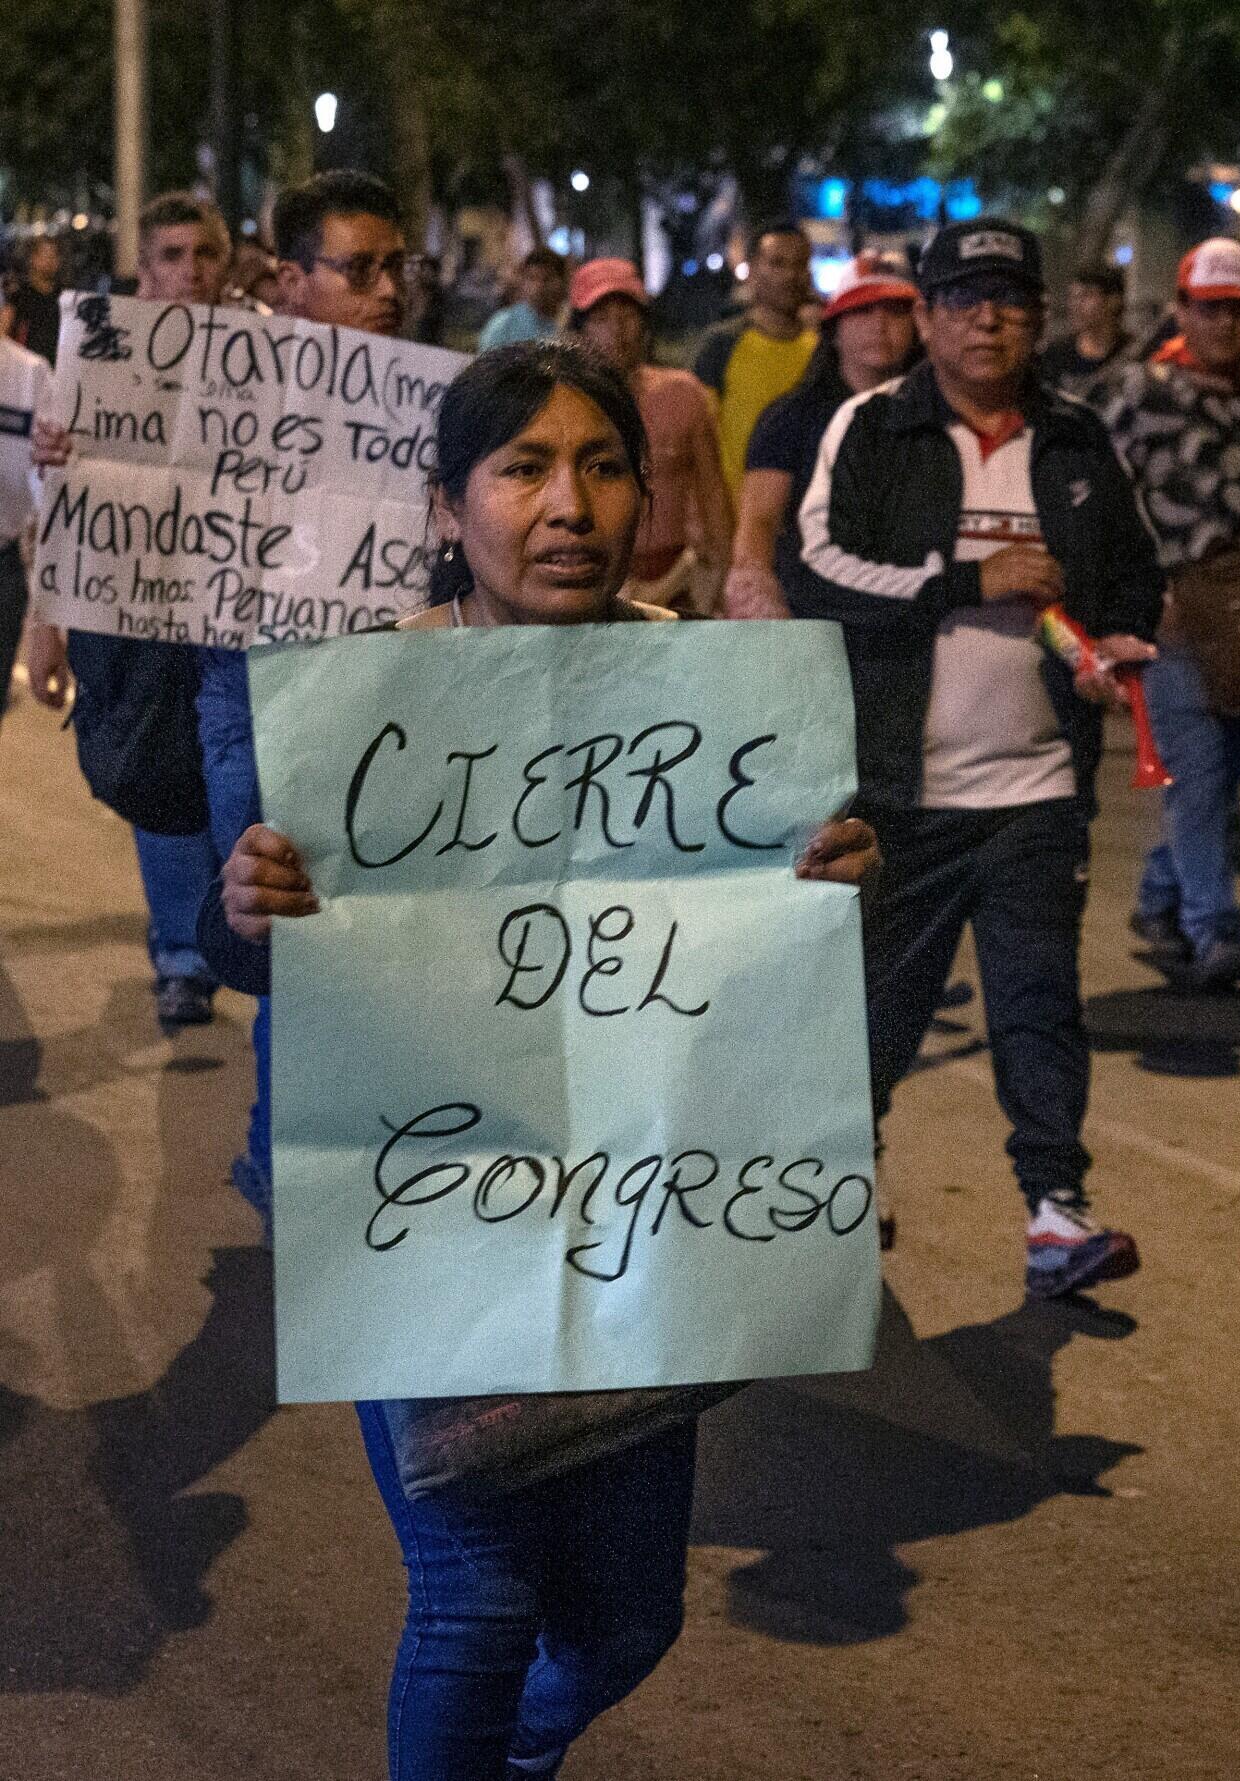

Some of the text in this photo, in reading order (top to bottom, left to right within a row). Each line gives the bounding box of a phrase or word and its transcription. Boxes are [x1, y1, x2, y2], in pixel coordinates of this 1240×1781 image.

[147, 304, 379, 407] Otarola
[68, 382, 168, 446] Lima
[198, 404, 260, 447] no
[271, 414, 323, 455] es
[40, 482, 292, 569] Mandaste
[40, 563, 60, 596] a
[74, 550, 118, 605] los
[207, 566, 399, 634] Peruanos
[344, 719, 786, 868] CIERRE
[495, 902, 710, 1017] DEL
